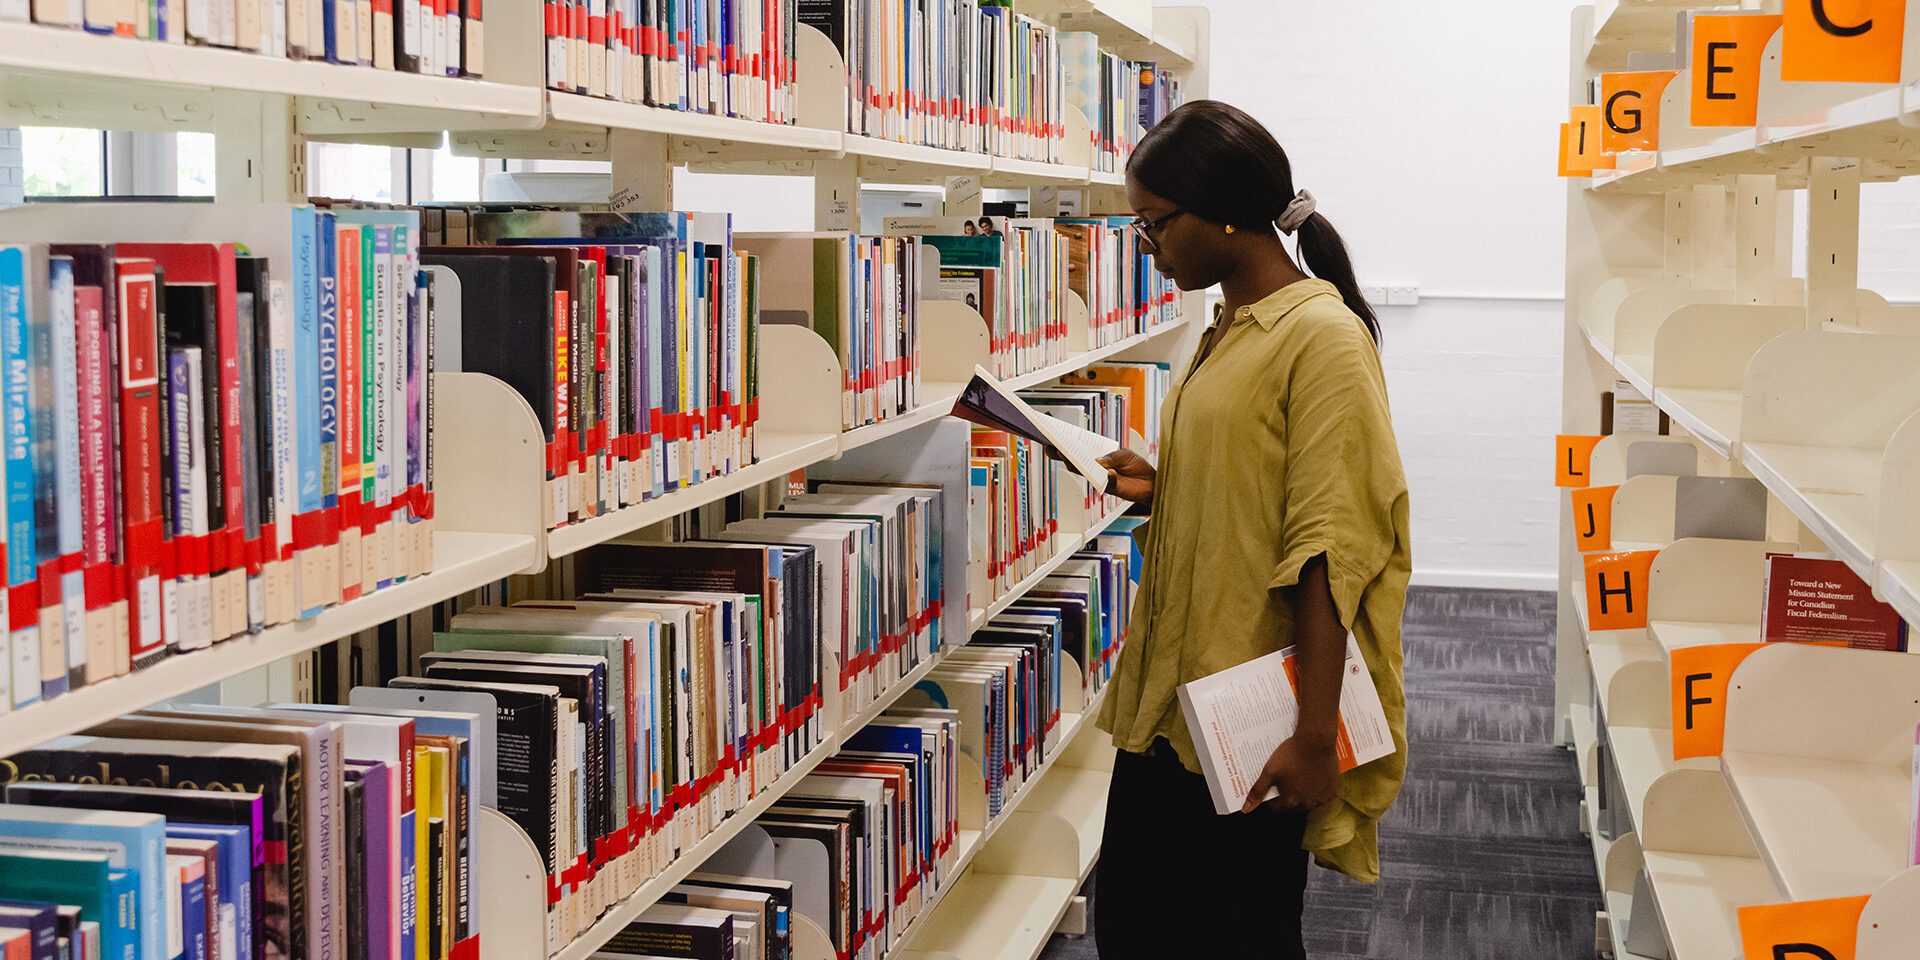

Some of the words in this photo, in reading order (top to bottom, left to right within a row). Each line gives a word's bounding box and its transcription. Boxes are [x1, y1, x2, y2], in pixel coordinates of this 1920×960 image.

[1706, 42, 1738, 100] E
[1605, 90, 1641, 134] G
[1578, 121, 1585, 156] I
[140, 287, 149, 310] The
[299, 235, 312, 333] Psychology
[377, 264, 385, 337] Statistics
[397, 303, 403, 314] in
[90, 309, 101, 395] REPORTING
[320, 276, 336, 435] PSYCHOLOGY
[377, 342, 385, 356] in
[347, 370, 354, 382] in
[367, 385, 373, 395] in
[557, 336, 568, 430] LIKEWAR
[11, 359, 29, 460] Miracle
[93, 398, 103, 416] IN
[94, 418, 103, 431] A
[141, 406, 149, 440] News
[346, 384, 354, 455] Psychology
[365, 397, 374, 457] Psychology
[376, 362, 385, 453] Psychology
[176, 392, 191, 488] Educational
[1568, 447, 1583, 476] L
[95, 432, 107, 527] MULTIMEDIA
[1582, 503, 1596, 538] J
[1598, 571, 1633, 614] H
[1787, 598, 1798, 607] for
[1799, 600, 1835, 609] Canadian
[1788, 589, 1816, 599] Mission
[1817, 590, 1854, 601] Statement
[1789, 578, 1817, 589] Toward
[1825, 581, 1841, 590] New
[1787, 608, 1807, 618] Fiscal
[1808, 609, 1847, 620] Federalism
[1685, 672, 1713, 730] F
[319, 738, 329, 791] MOTOR
[319, 795, 330, 873] LEARNING
[550, 759, 559, 875] COMMEMORATIONS
[321, 875, 330, 894] AND
[460, 856, 468, 902] REACHING
[402, 874, 411, 936] Behavior
[460, 905, 468, 924] OUT
